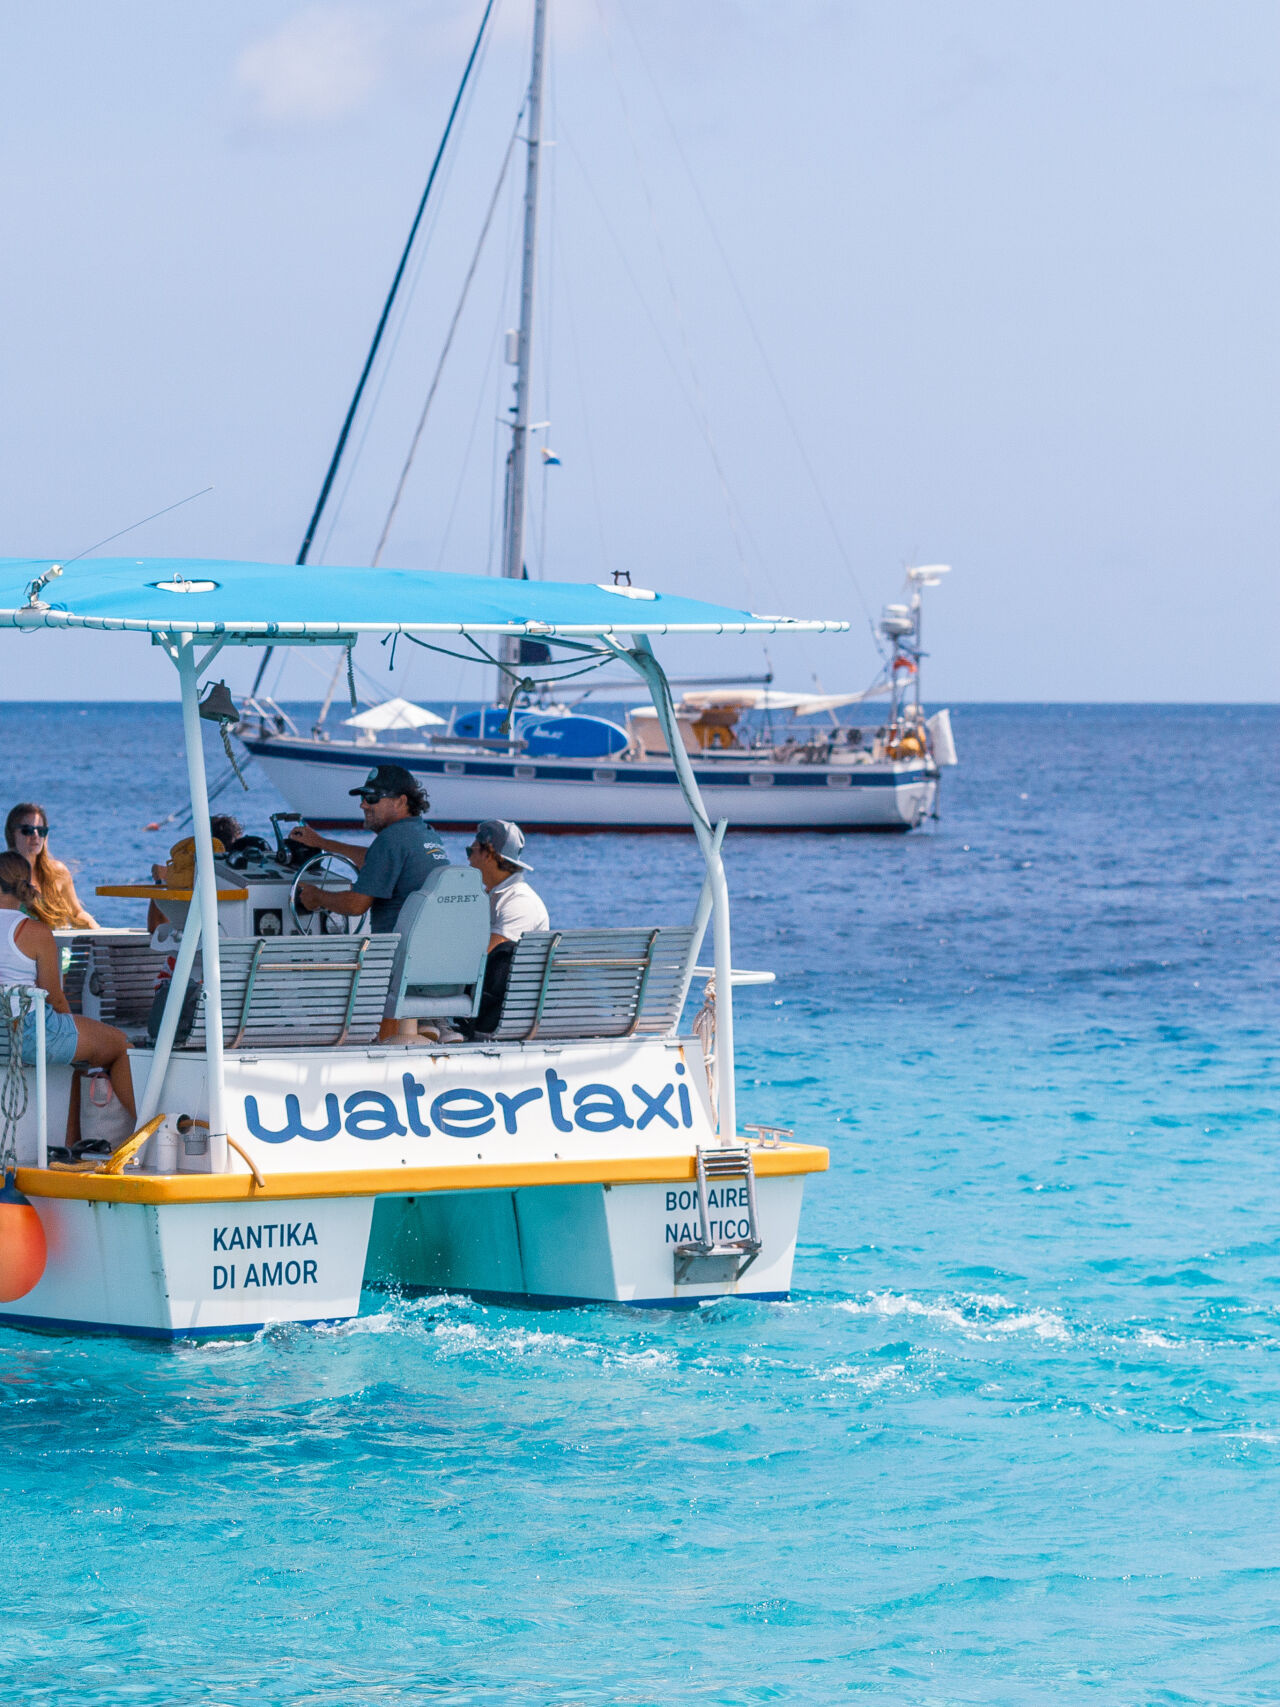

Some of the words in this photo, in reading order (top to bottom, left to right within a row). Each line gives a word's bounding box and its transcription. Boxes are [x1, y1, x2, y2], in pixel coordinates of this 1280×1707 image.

[437, 894, 479, 904] OSPREY
[244, 1062, 693, 1144] watertaxi
[213, 1222, 319, 1252] KANTIKA
[213, 1264, 235, 1290] DI
[243, 1259, 319, 1289] AMOR
